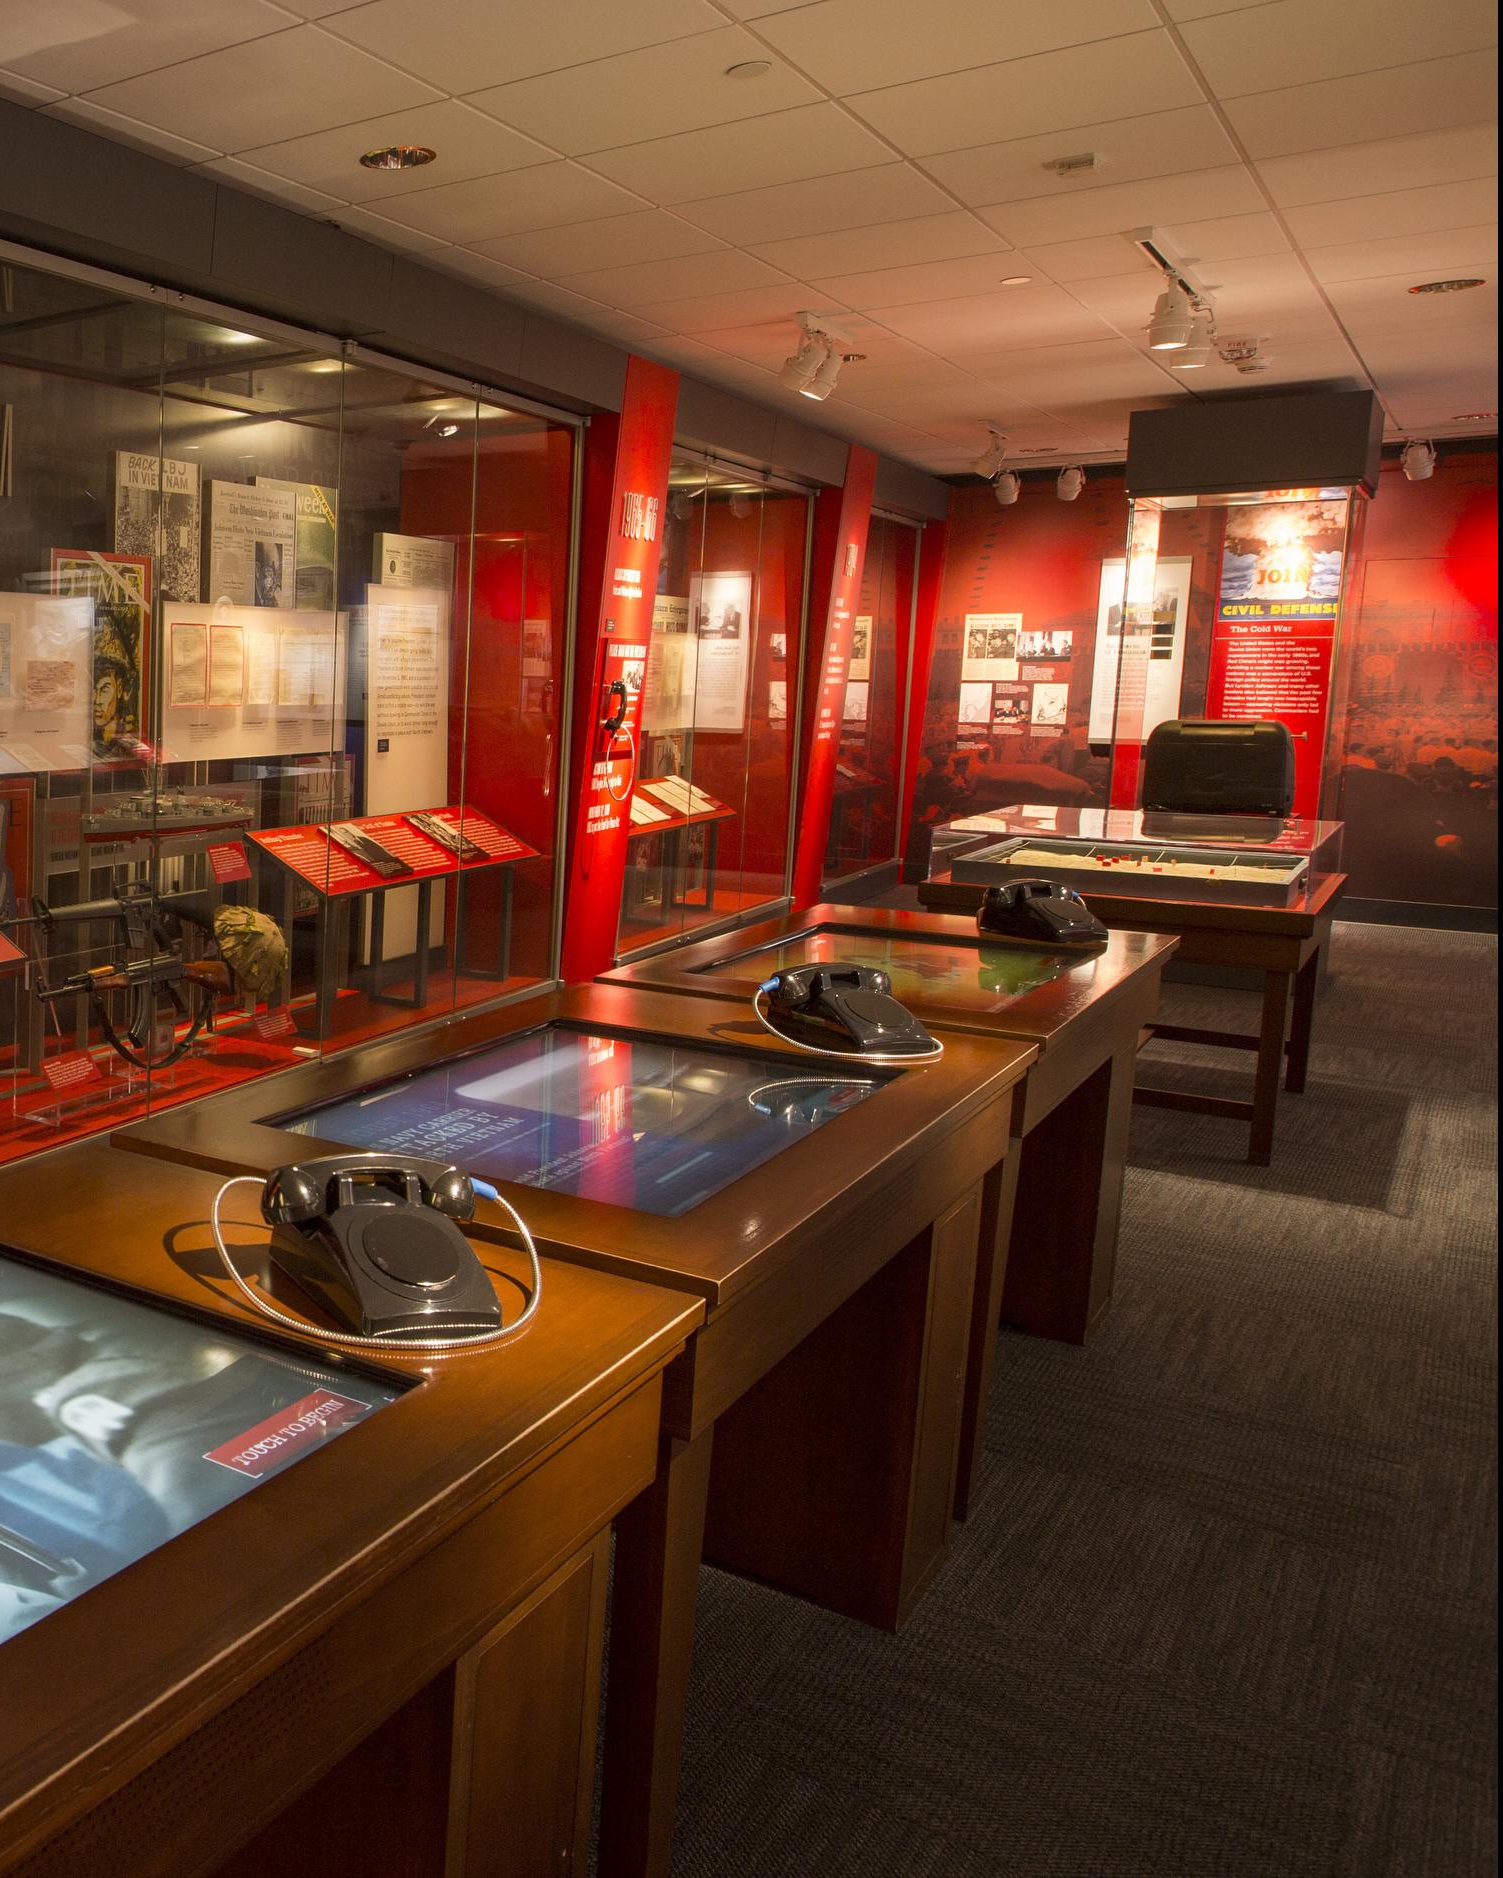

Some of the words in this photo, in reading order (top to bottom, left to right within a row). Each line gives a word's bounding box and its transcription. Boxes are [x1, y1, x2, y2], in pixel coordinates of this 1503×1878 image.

[128, 456, 156, 472] BACK
[128, 470, 139, 485] IN
[166, 475, 188, 490] NAM
[1222, 605, 1264, 615] CIVIL
[1250, 625, 1271, 633] Cold
[468, 1111, 499, 1124] BY
[456, 1116, 525, 1144] VIETNAM
[232, 1433, 288, 1466] TOUCH
[280, 1423, 306, 1437] TO
[298, 1399, 345, 1427] BEGIN
